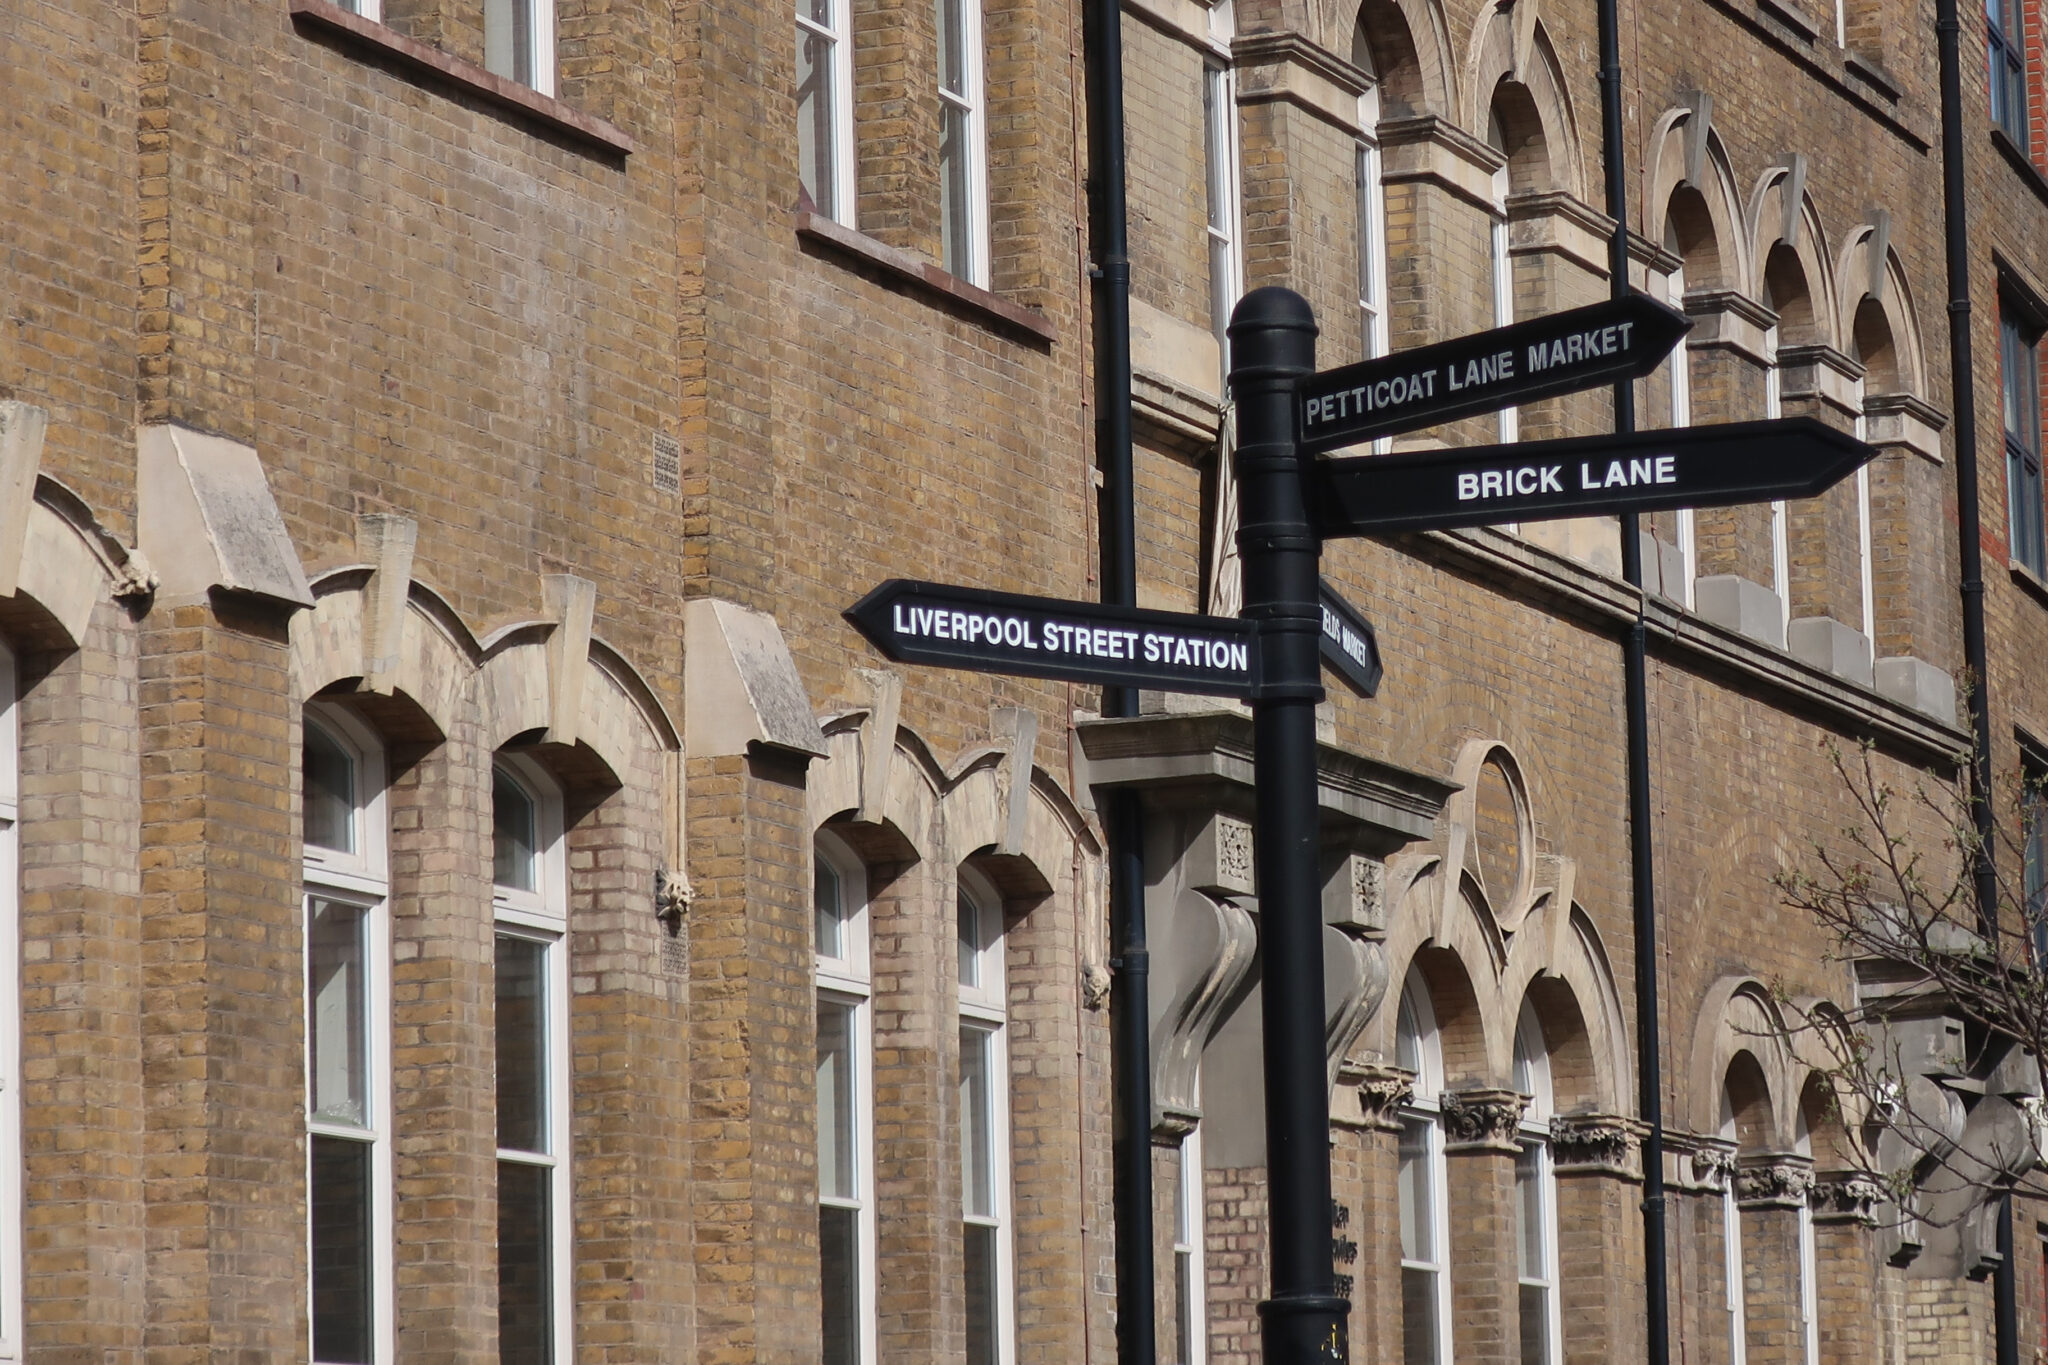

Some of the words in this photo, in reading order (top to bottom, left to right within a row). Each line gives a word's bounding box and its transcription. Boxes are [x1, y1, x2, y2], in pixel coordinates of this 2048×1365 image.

[1307, 369, 1437, 425] PETTICOAT
[1448, 351, 1514, 391] LANE
[1528, 322, 1634, 373] MARKET
[1458, 463, 1564, 501] BRICK
[1581, 456, 1677, 490] LANE
[893, 604, 1038, 650] LIVERPOOL
[1043, 621, 1139, 660] STREET
[1143, 633, 1248, 671] STATION
[1320, 604, 1341, 645] IELDS
[1342, 625, 1366, 668] MARKET
